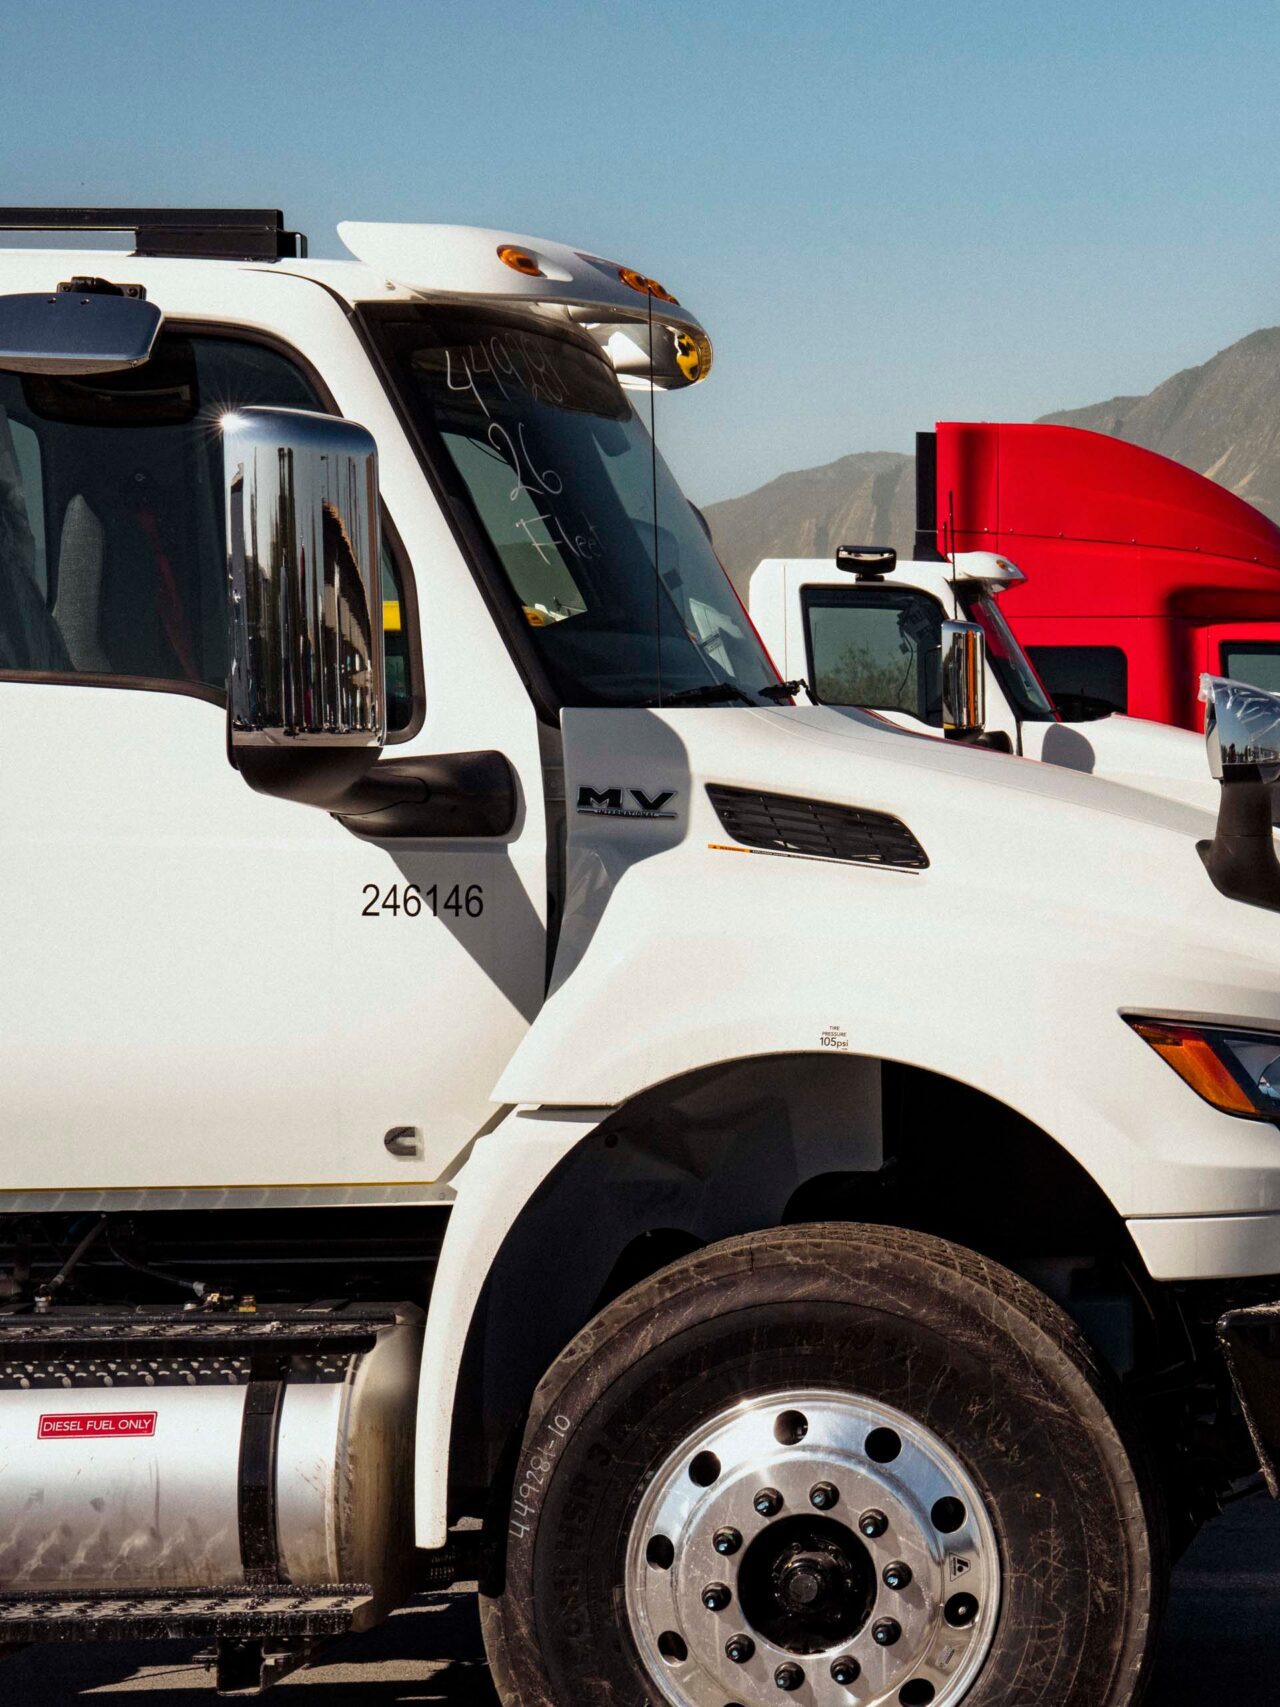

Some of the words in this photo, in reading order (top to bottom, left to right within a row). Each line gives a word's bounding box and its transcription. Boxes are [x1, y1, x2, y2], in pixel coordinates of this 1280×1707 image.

[488, 422, 563, 500] 26
[515, 511, 607, 566] Fleet
[576, 785, 679, 811] MV
[361, 883, 484, 918] 246146
[819, 1036, 849, 1048] 105psi
[43, 1420, 83, 1432] DIESEL
[86, 1420, 115, 1431] FUEL
[118, 1418, 152, 1430] ONLY
[508, 1414, 571, 1539] 449281-10
